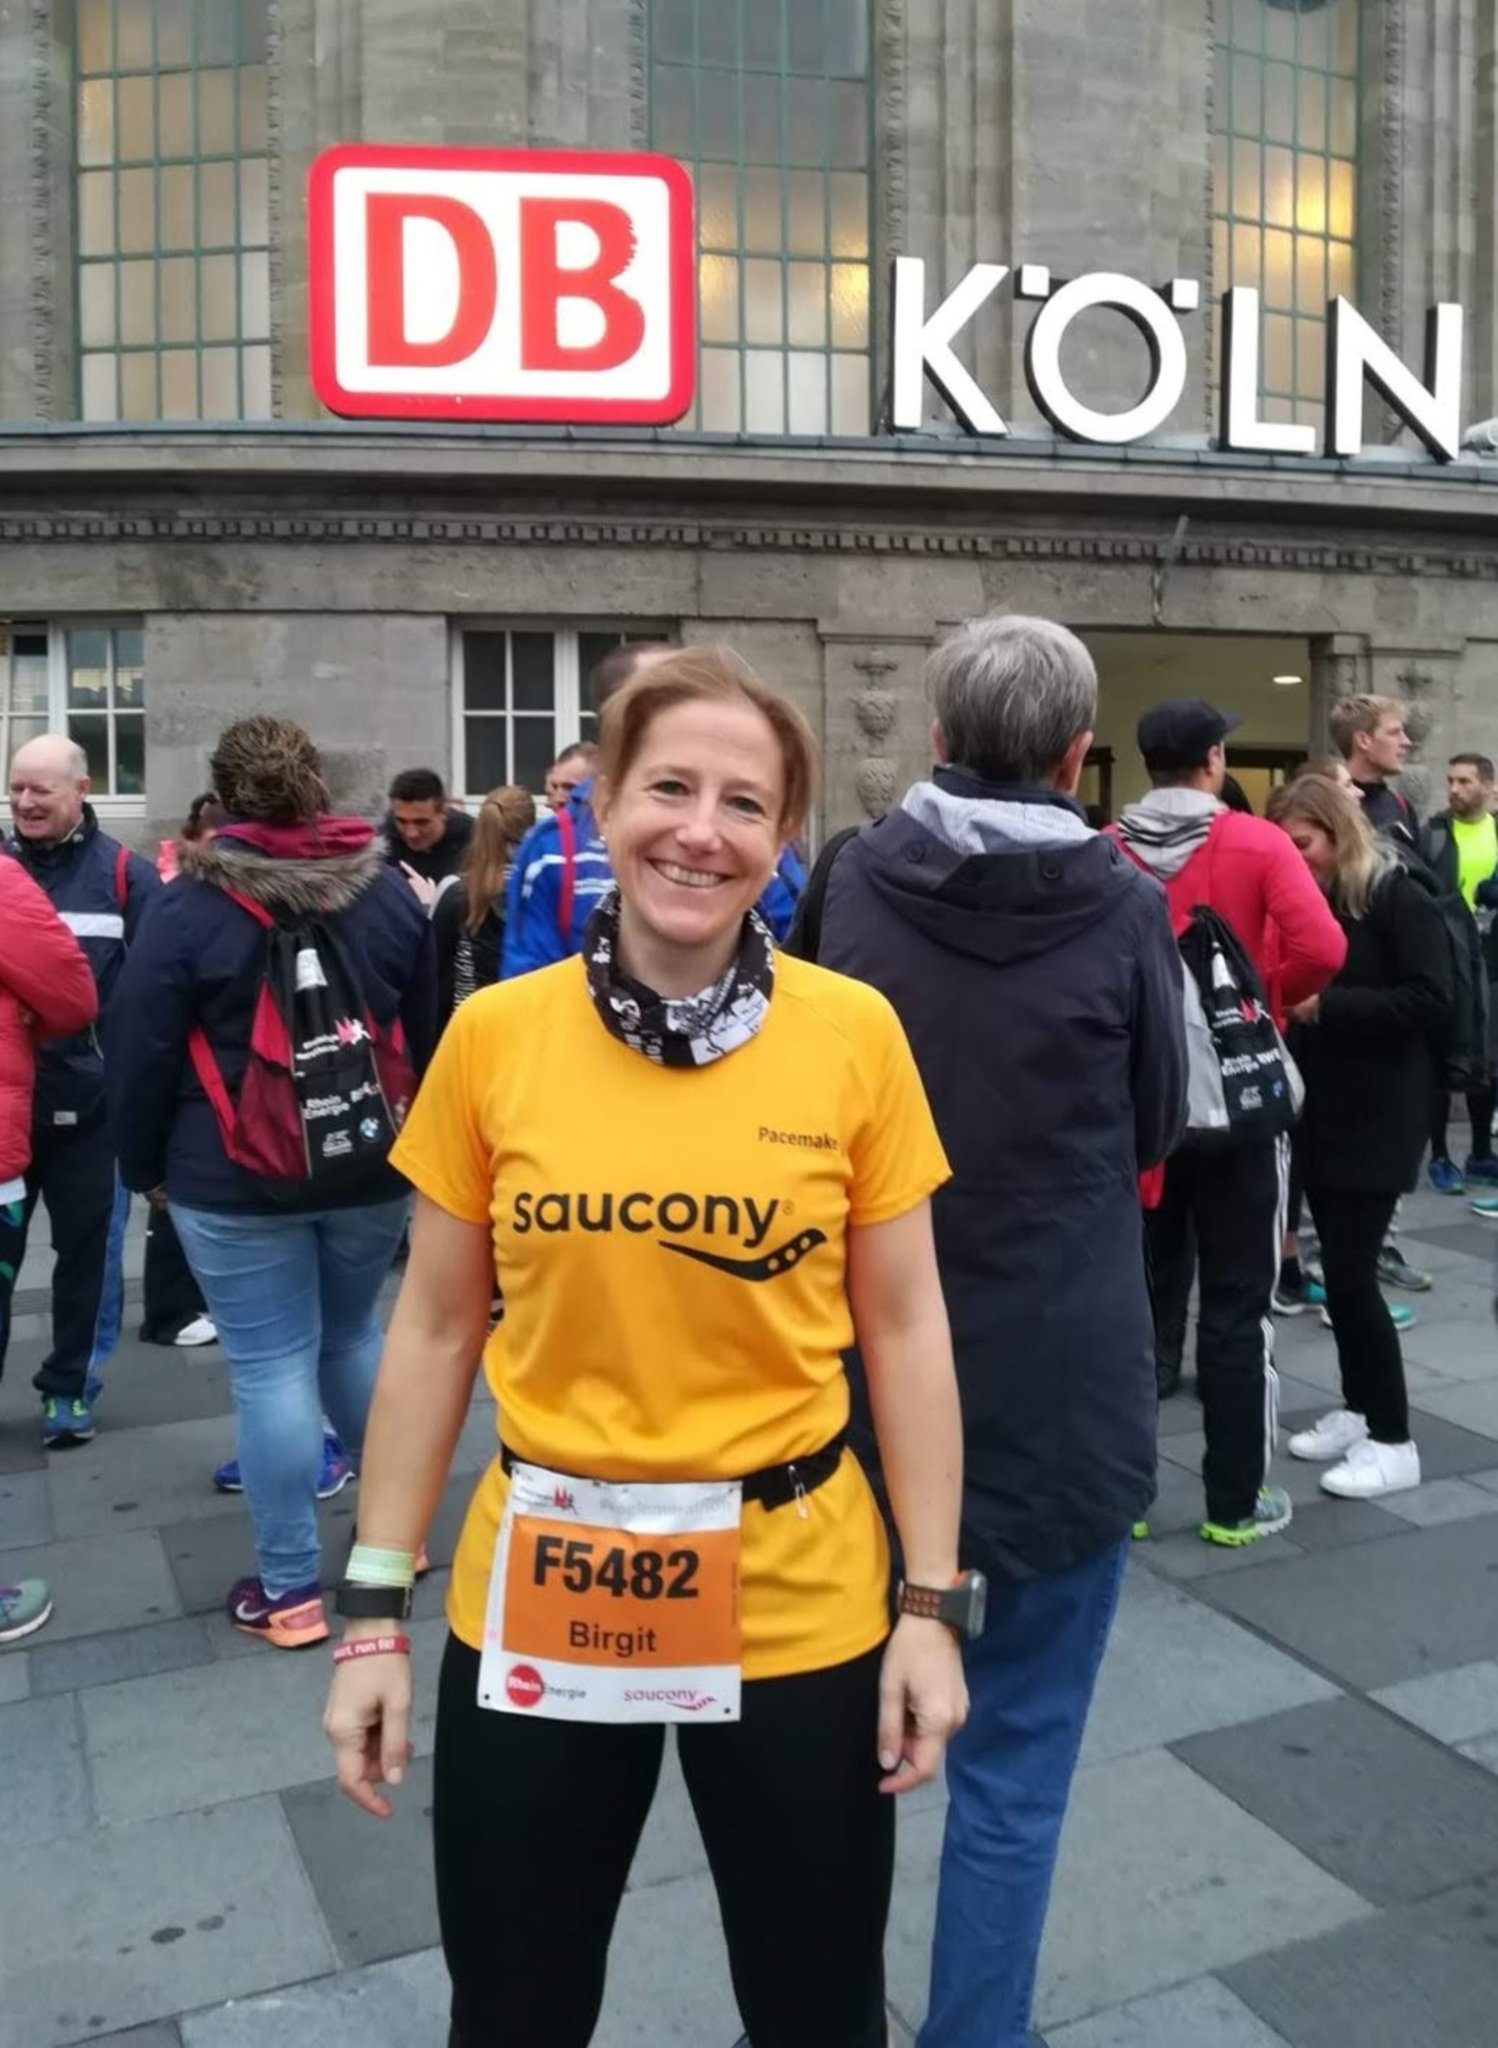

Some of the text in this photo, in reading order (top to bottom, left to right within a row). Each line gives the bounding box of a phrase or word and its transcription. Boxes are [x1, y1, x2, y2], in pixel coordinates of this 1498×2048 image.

[364, 192, 646, 372] DB
[892, 255, 1463, 462] KÖLN
[533, 1534, 700, 1600] F5482
[569, 1620, 657, 1658] Birgit
[624, 1688, 698, 1702] saucony
